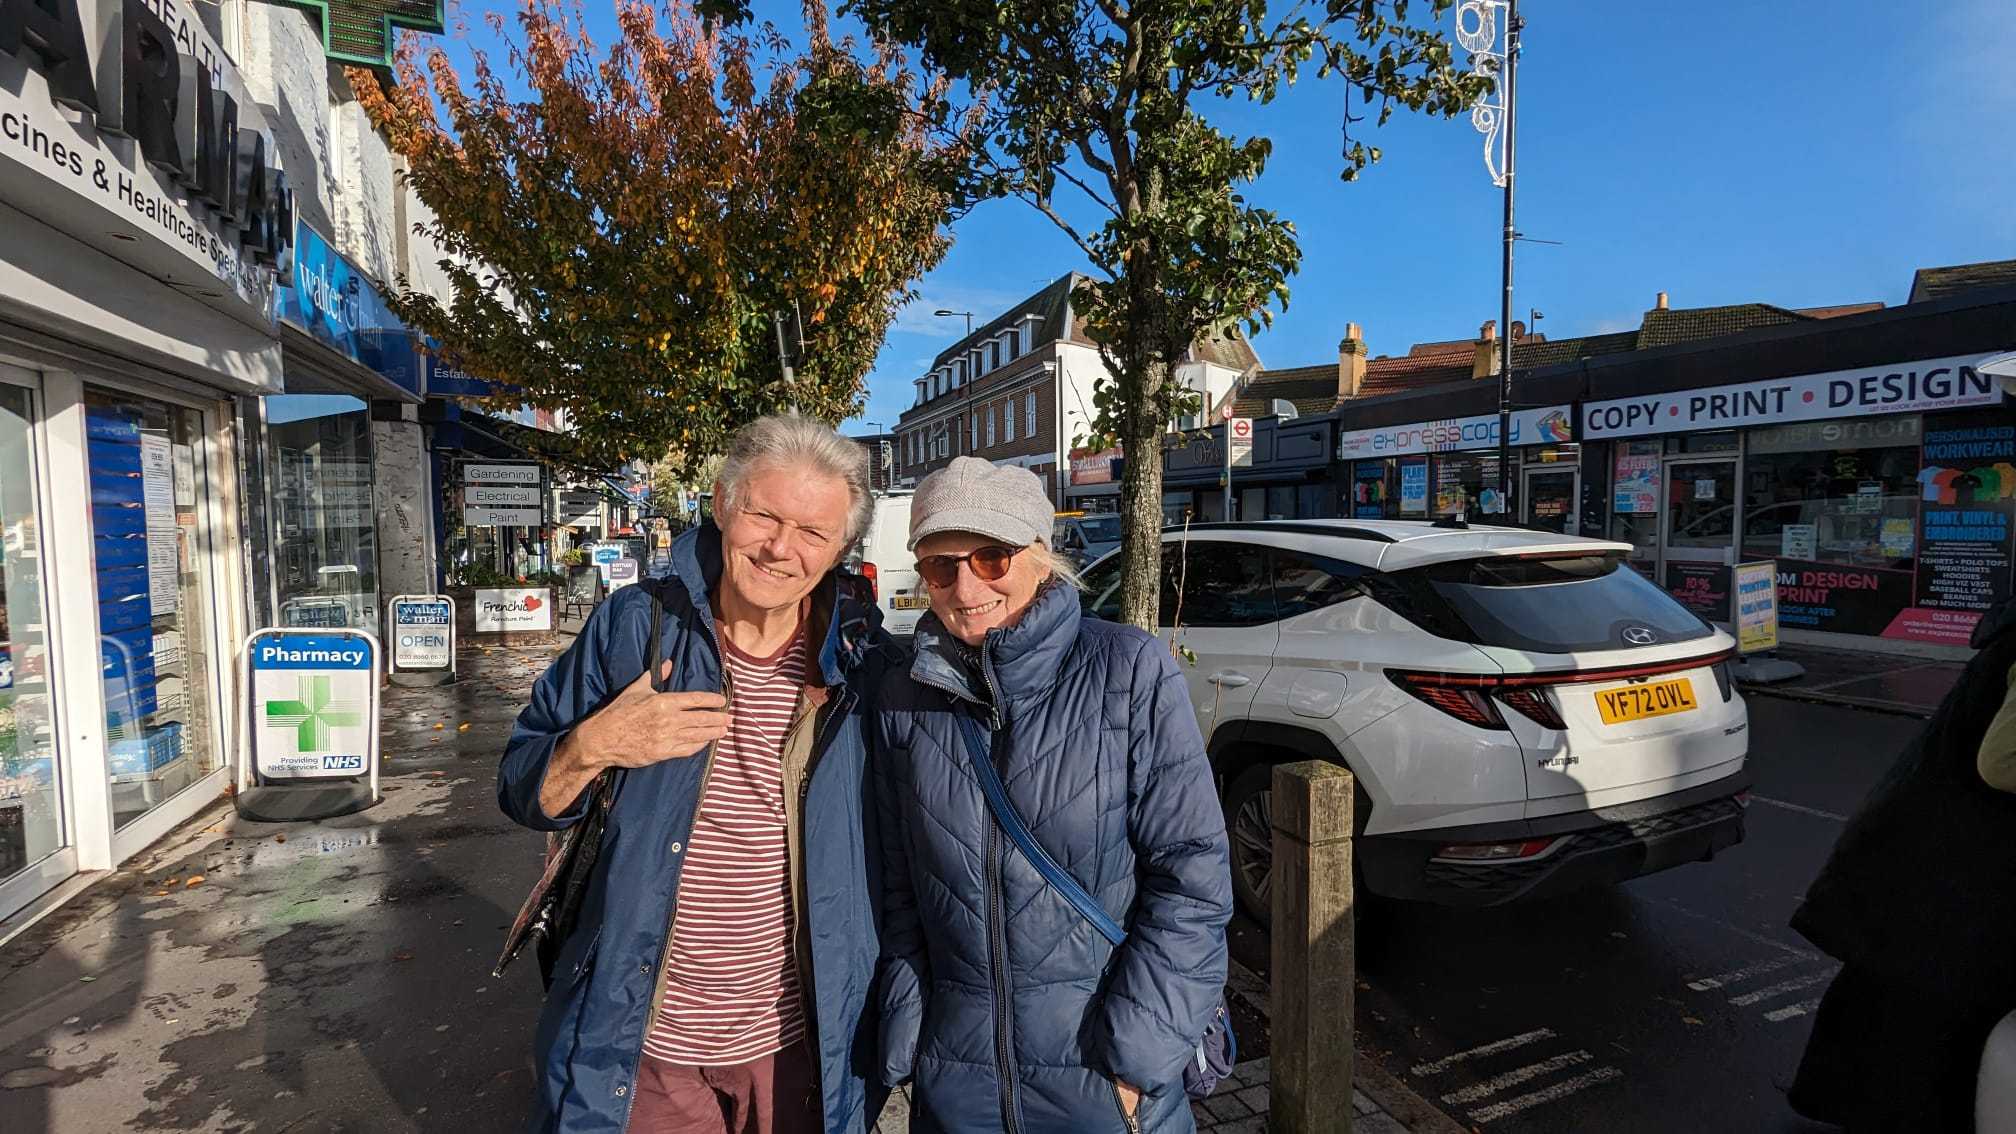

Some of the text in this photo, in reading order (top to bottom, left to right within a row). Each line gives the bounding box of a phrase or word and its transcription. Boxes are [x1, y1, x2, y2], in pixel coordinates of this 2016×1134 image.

[93, 160, 109, 193] &
[118, 167, 206, 254] Healthcare
[299, 262, 342, 323] walter
[434, 366, 472, 380] Estat
[1588, 365, 1992, 431] COPY PRINT DESIGN
[1924, 440, 2015, 459] WORKWEAR
[470, 468, 534, 482] Gardening
[476, 491, 530, 502] Electrical
[489, 511, 519, 523] Paint
[1920, 558, 1954, 566] T-SHIRTS
[1934, 565, 1990, 573] SWEATSHIRTS
[1802, 571, 1878, 590] DESIGN
[1943, 572, 1981, 580] HOODIES
[1777, 587, 1829, 603] PRINT
[1929, 586, 1993, 595] BASEBALL CAPS
[1919, 598, 1938, 606] AND
[1943, 593, 1978, 601] BEANIES
[403, 604, 444, 614] walter
[400, 635, 444, 647] OPEN
[262, 647, 364, 667] Pharmacy
[1604, 682, 1690, 718] YF72 OVL
[281, 756, 319, 766] Providing
[287, 763, 318, 771] Services
[324, 756, 361, 769] NHS
[1538, 756, 1580, 768] HYUNDAI
